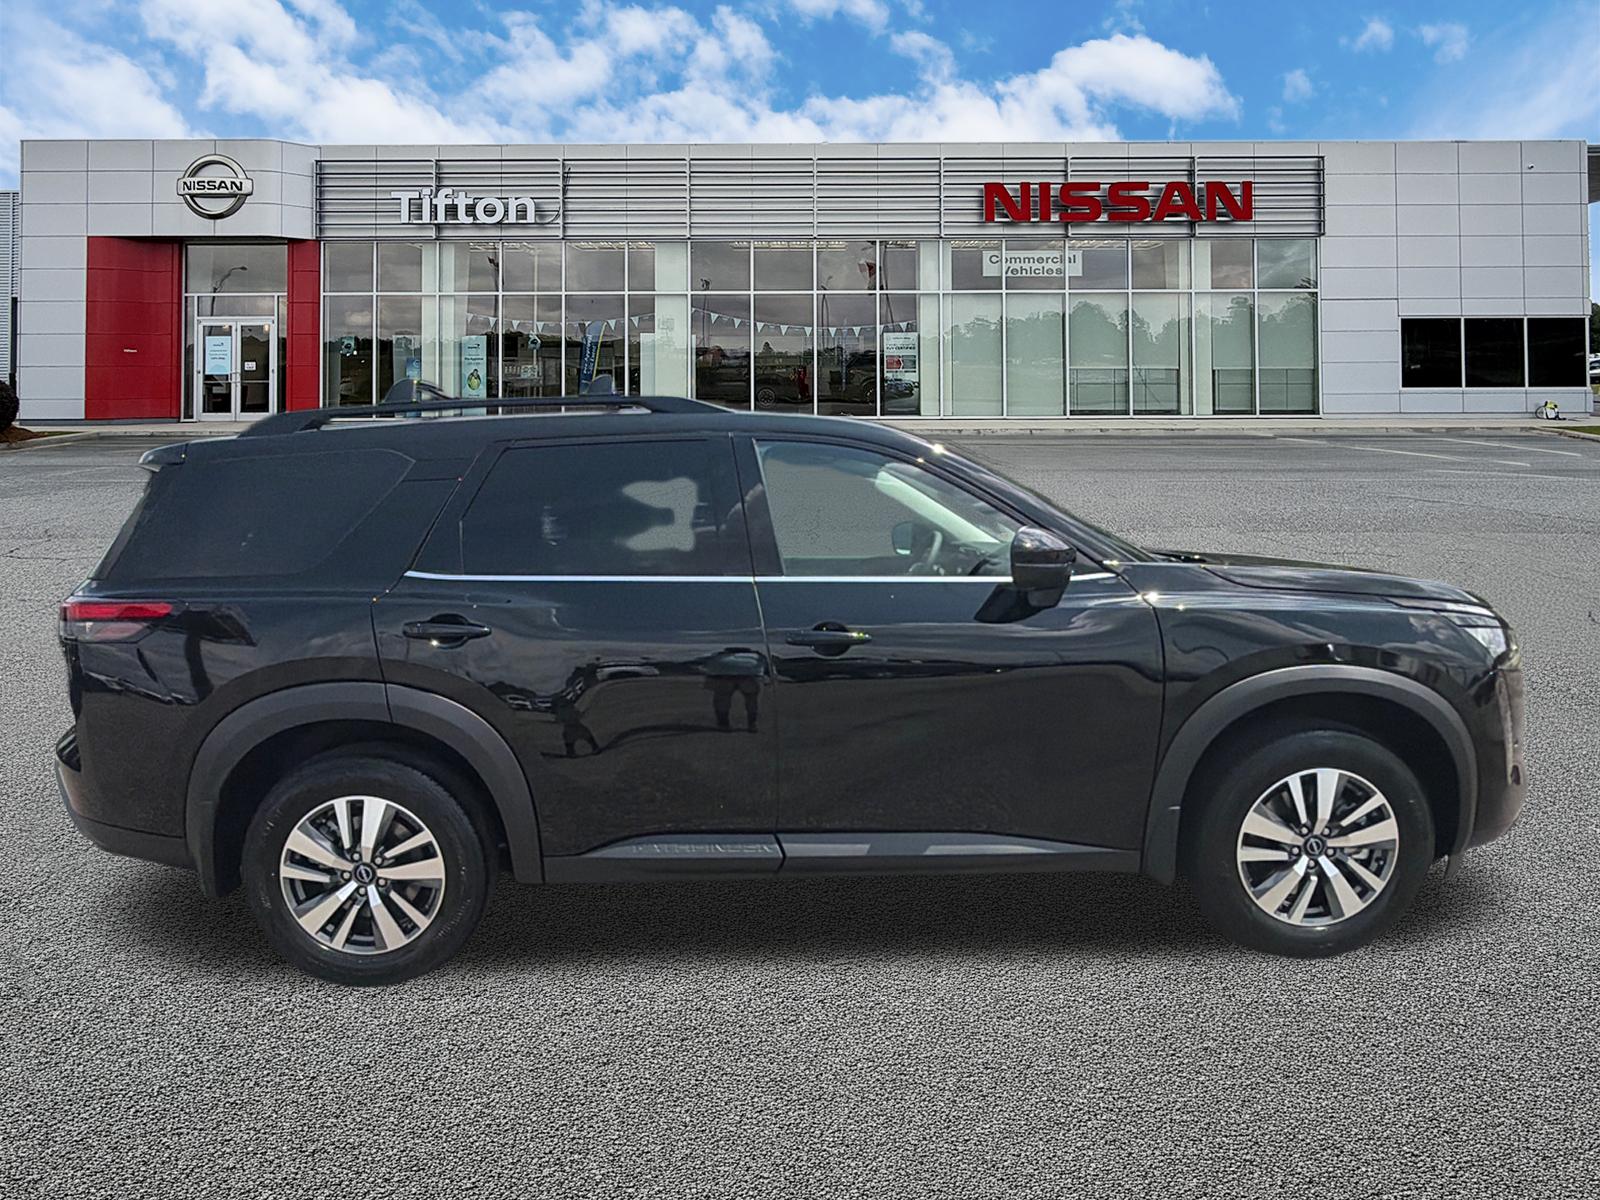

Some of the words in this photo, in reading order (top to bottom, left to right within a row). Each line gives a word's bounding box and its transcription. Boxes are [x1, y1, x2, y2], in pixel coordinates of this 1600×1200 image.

[182, 180, 243, 191] NISSAN
[983, 180, 1253, 222] NISSAN
[390, 187, 537, 224] Tifton
